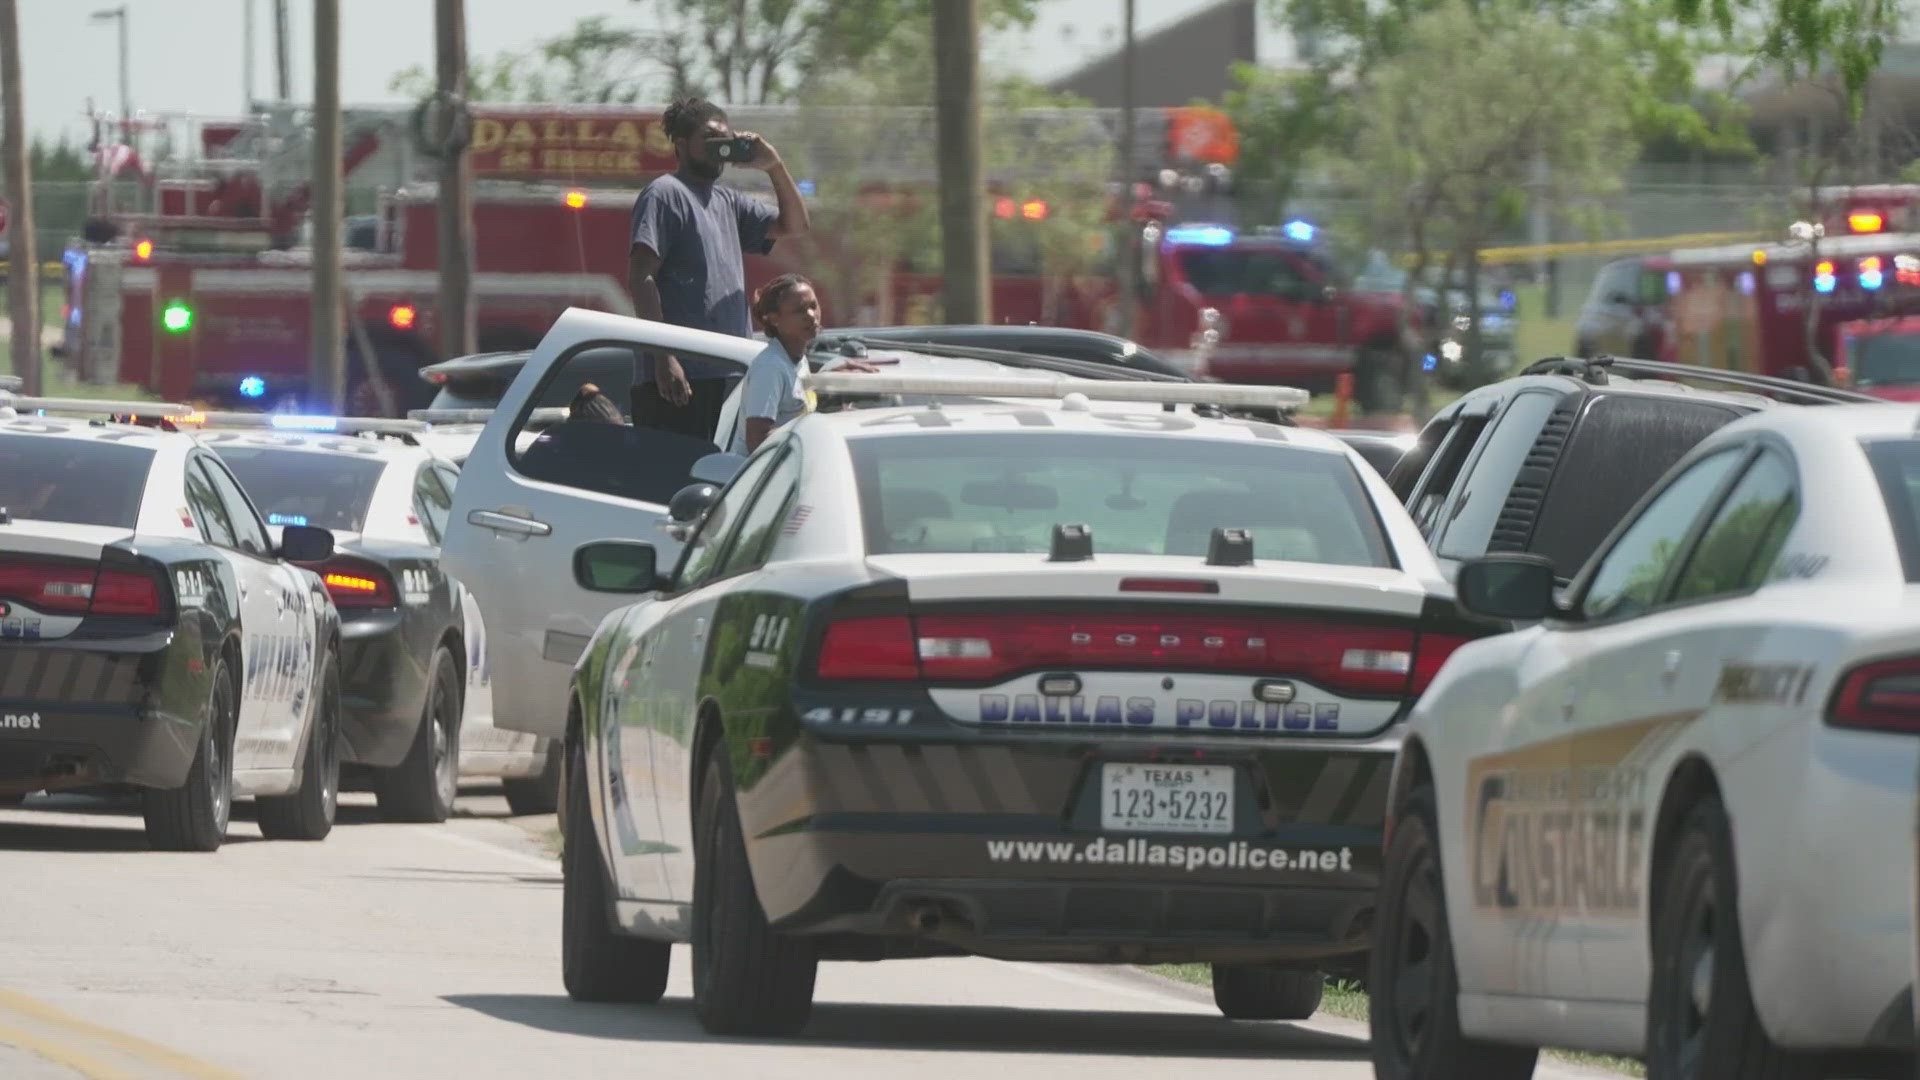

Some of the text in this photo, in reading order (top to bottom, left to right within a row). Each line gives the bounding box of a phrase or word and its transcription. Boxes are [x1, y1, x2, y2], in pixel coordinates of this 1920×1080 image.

[470, 118, 676, 157] DALLAS
[1071, 632, 1266, 648] DODGE
[801, 706, 914, 725] 4191
[979, 693, 1340, 731] DALLAS POLICE
[1143, 769, 1194, 783] TEXAS
[986, 837, 1353, 871] www.dallaspolice.net
